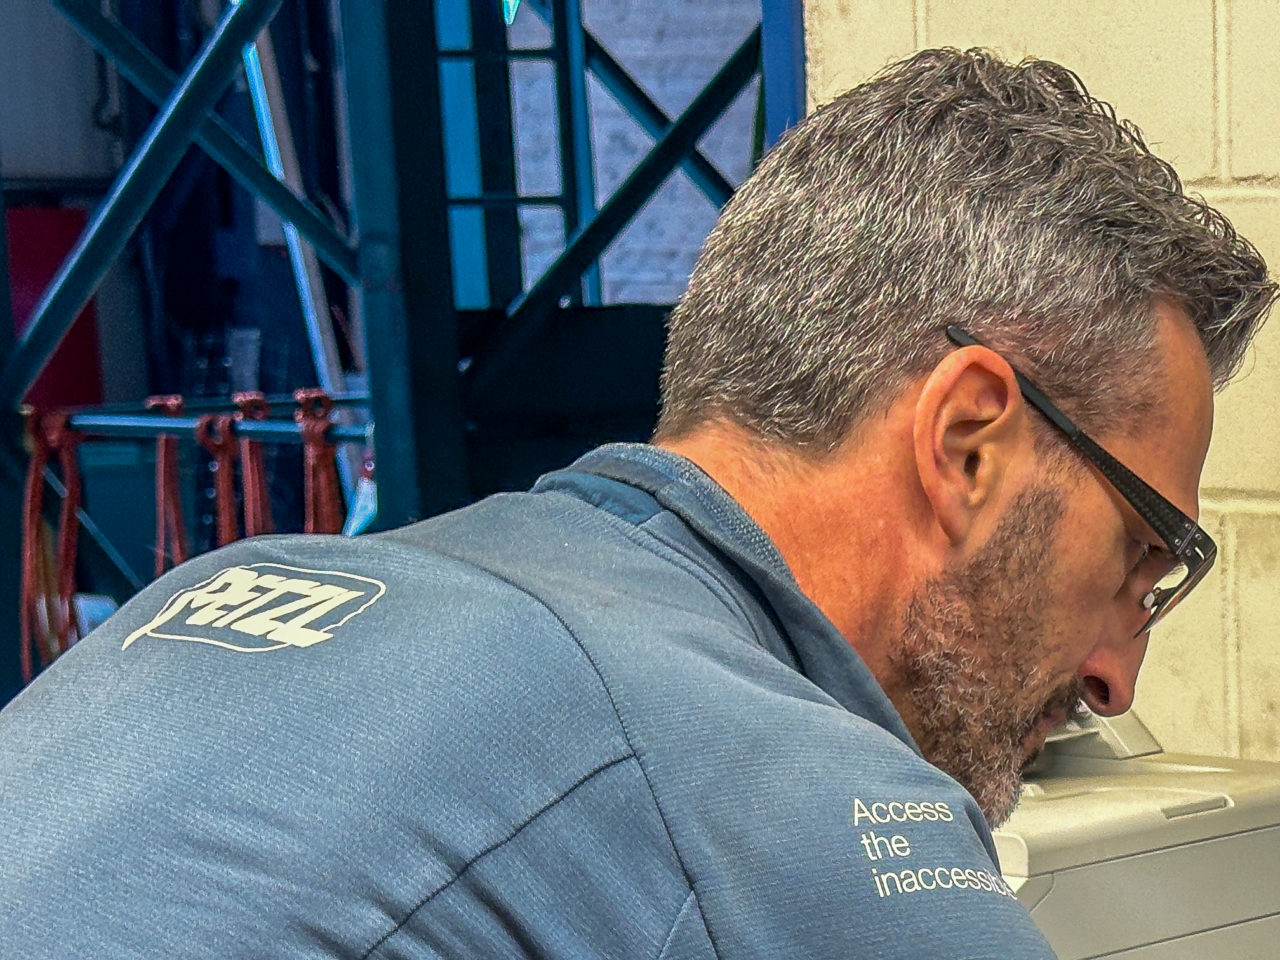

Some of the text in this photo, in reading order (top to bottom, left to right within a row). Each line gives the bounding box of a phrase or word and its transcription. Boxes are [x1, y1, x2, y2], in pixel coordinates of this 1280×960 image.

[121, 566, 366, 651] PETZL
[853, 798, 954, 827] Access
[860, 831, 911, 861] the
